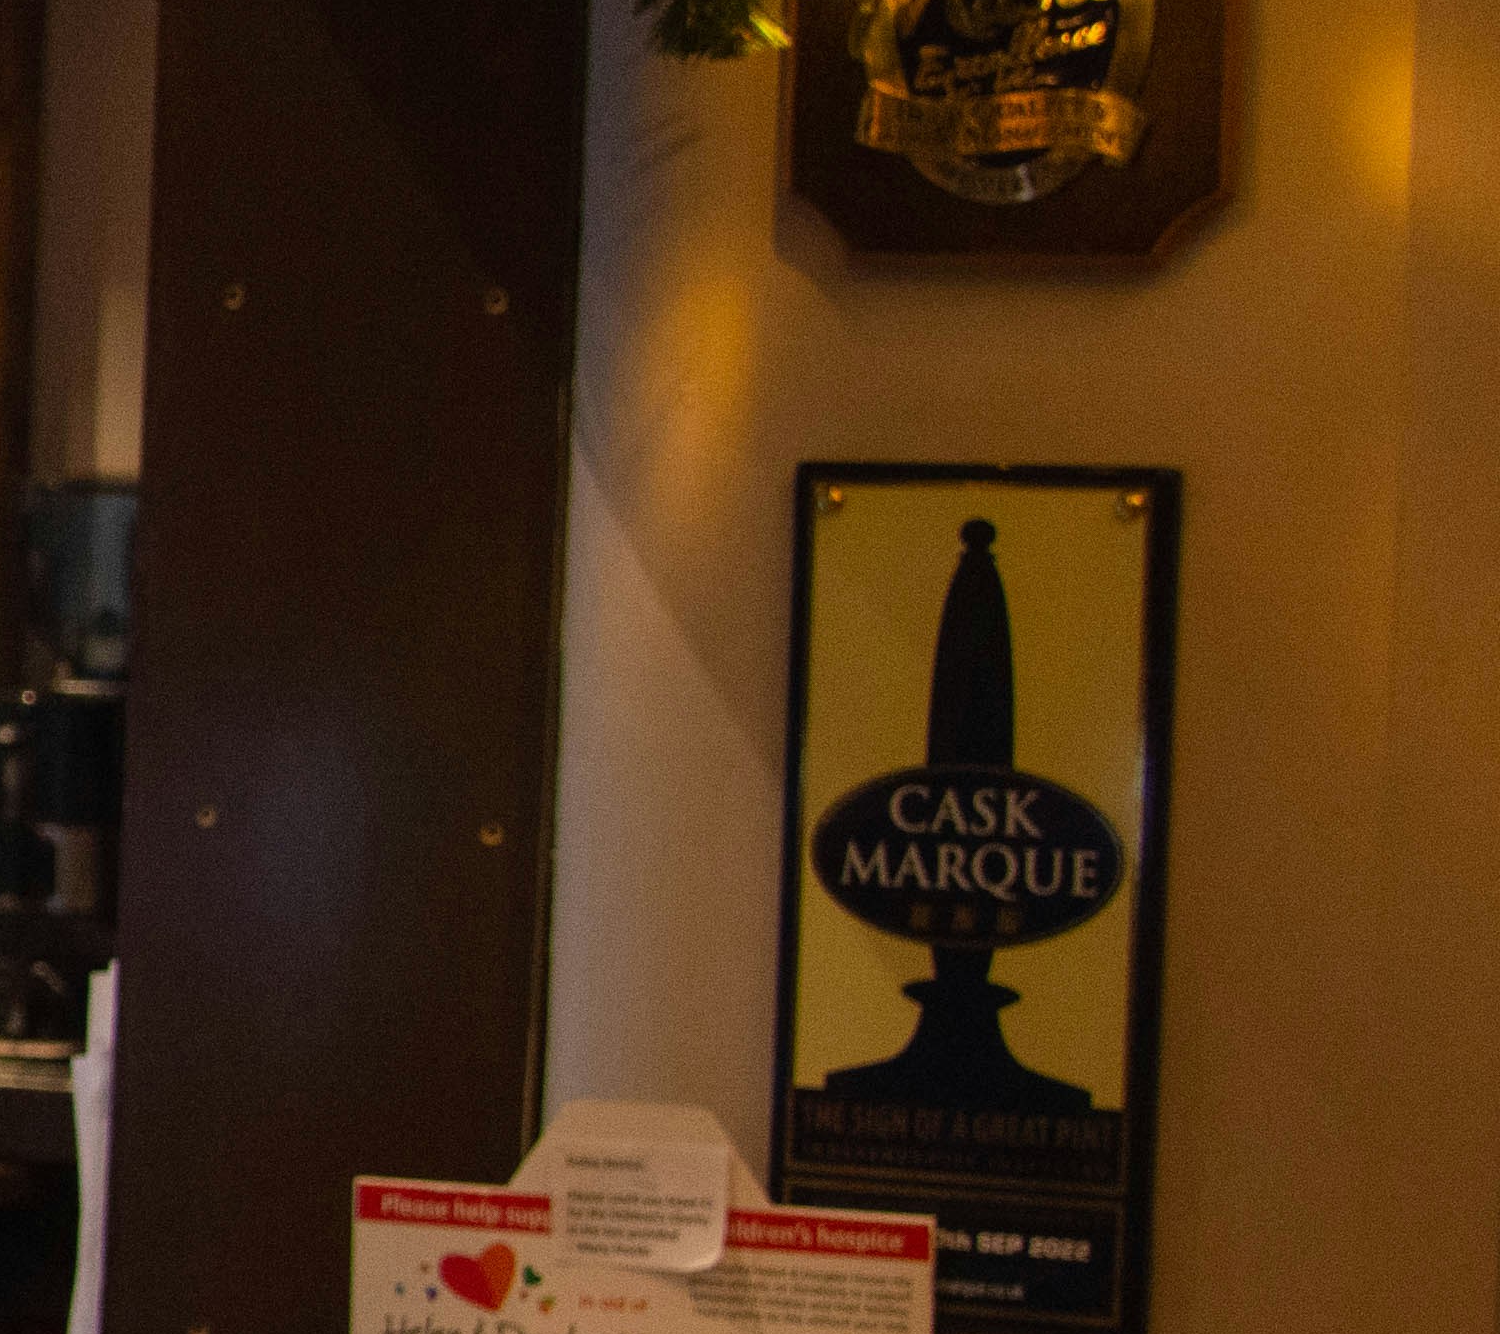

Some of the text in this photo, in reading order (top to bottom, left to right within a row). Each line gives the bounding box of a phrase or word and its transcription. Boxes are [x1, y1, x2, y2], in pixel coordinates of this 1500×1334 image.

[888, 782, 1045, 841] CASK
[840, 841, 1101, 902] MARQUE
[380, 1192, 449, 1216] Please
[454, 1198, 501, 1226] help
[816, 1221, 905, 1255] hospice
[975, 1230, 1024, 1255] SEP
